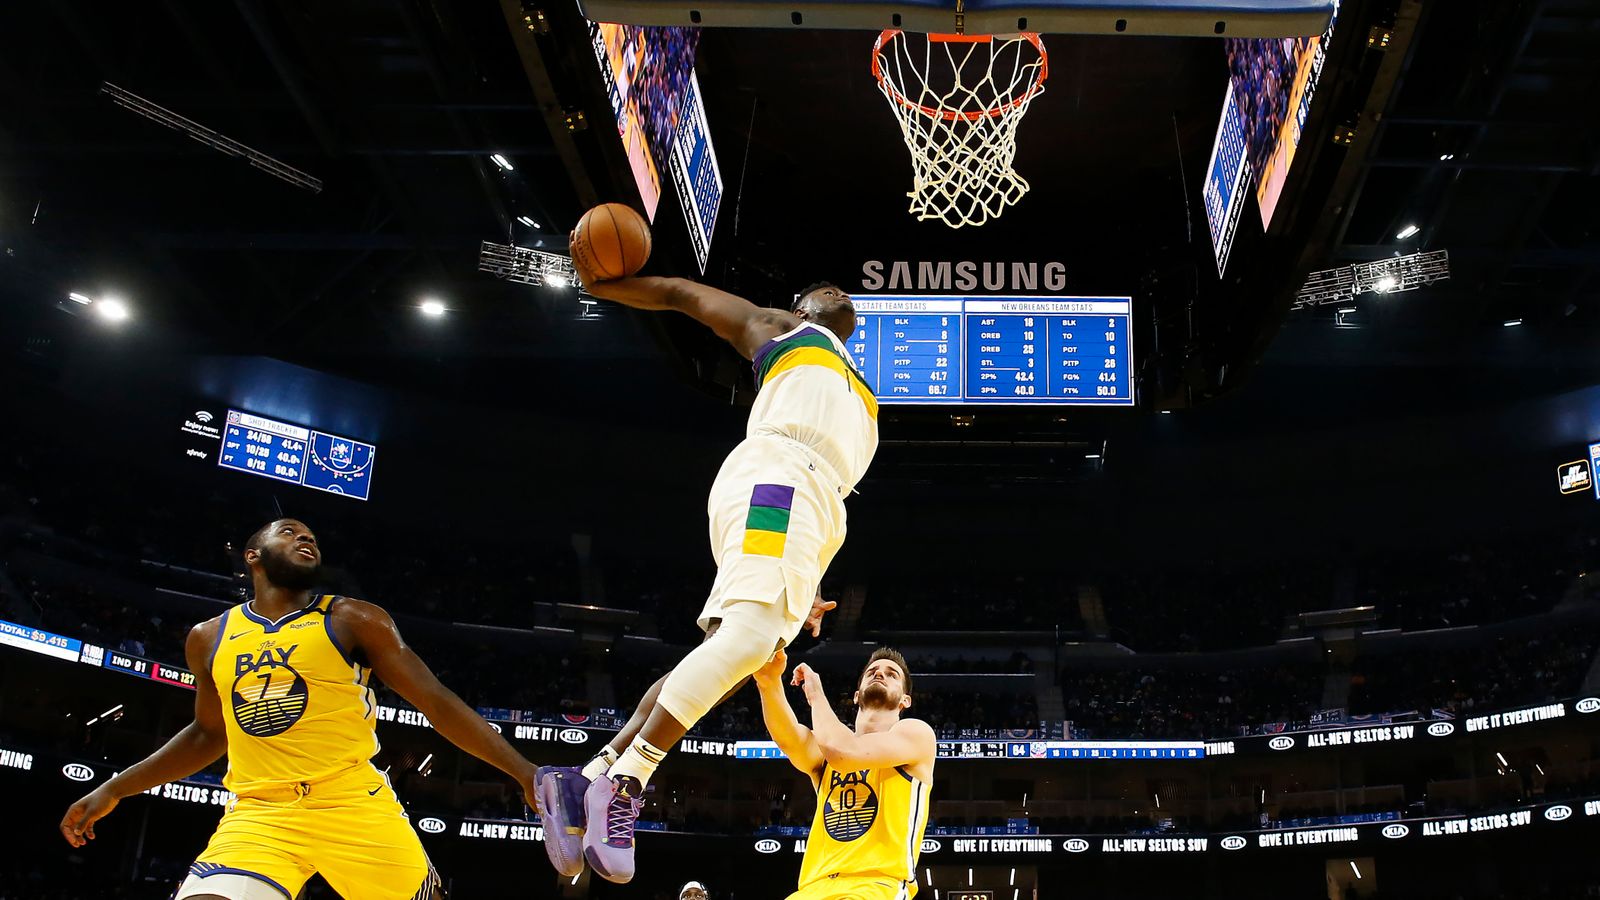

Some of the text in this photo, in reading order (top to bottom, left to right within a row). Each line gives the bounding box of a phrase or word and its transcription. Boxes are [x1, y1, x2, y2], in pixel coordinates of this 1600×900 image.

[862, 260, 1066, 291] SAMSUNG
[861, 302, 882, 310] STATE
[884, 302, 904, 310] TEAM
[904, 302, 928, 311] STATS
[1001, 303, 1094, 312] NEW ORLEANS TEAM STATS
[894, 318, 909, 326] BLK
[1108, 318, 1115, 328] 2
[980, 331, 1034, 341] OREB 10
[1104, 332, 1115, 342] 10
[854, 344, 866, 354] 27
[938, 344, 948, 354] 13
[1022, 345, 1034, 354] 25
[859, 357, 866, 367] 7
[936, 357, 948, 368] 22
[1028, 358, 1034, 368] 3
[930, 371, 948, 382] 41.7
[1014, 372, 1034, 382] 42.4
[1098, 372, 1116, 382] 41.4
[894, 386, 910, 394] FT%
[1014, 386, 1034, 396] 40.0
[1096, 386, 1117, 396] 50.0
[185, 420, 203, 431] Enjoy
[0, 623, 69, 649] TOTAL: $9,415
[256, 640, 276, 652] The
[112, 655, 147, 674] IND 81
[235, 644, 299, 677] BAY
[159, 668, 196, 686] TOR 127
[256, 673, 272, 700] 7
[1308, 730, 1352, 748] ALL-NEW
[1353, 726, 1392, 744] SELTOS
[1393, 726, 1415, 740] SUV
[1466, 716, 1490, 733] GIVE
[1490, 714, 1502, 728] IT
[1502, 702, 1566, 726] EVERYTHING
[514, 726, 540, 741] GIVE
[540, 728, 554, 741] IT
[680, 740, 726, 756] ALL-NEW
[830, 768, 870, 789] BAY
[163, 782, 210, 804] SELTOS
[840, 788, 856, 810] 10
[459, 822, 510, 840] ALL-NEW
[954, 839, 977, 852] GIVE
[978, 839, 989, 852] IT
[991, 839, 1052, 852] EVERYTHING
[1102, 838, 1147, 852] ALL-NEW
[1148, 838, 1186, 852] SELTOS
[1187, 838, 1208, 852] SUV
[1258, 833, 1283, 848] GIVE
[1283, 832, 1294, 846] IT
[1296, 827, 1359, 845] EVERYTHING
[1422, 819, 1469, 836] ALL-NEW
[1469, 814, 1509, 832] SELTOS
[1510, 810, 1532, 826] SUV
